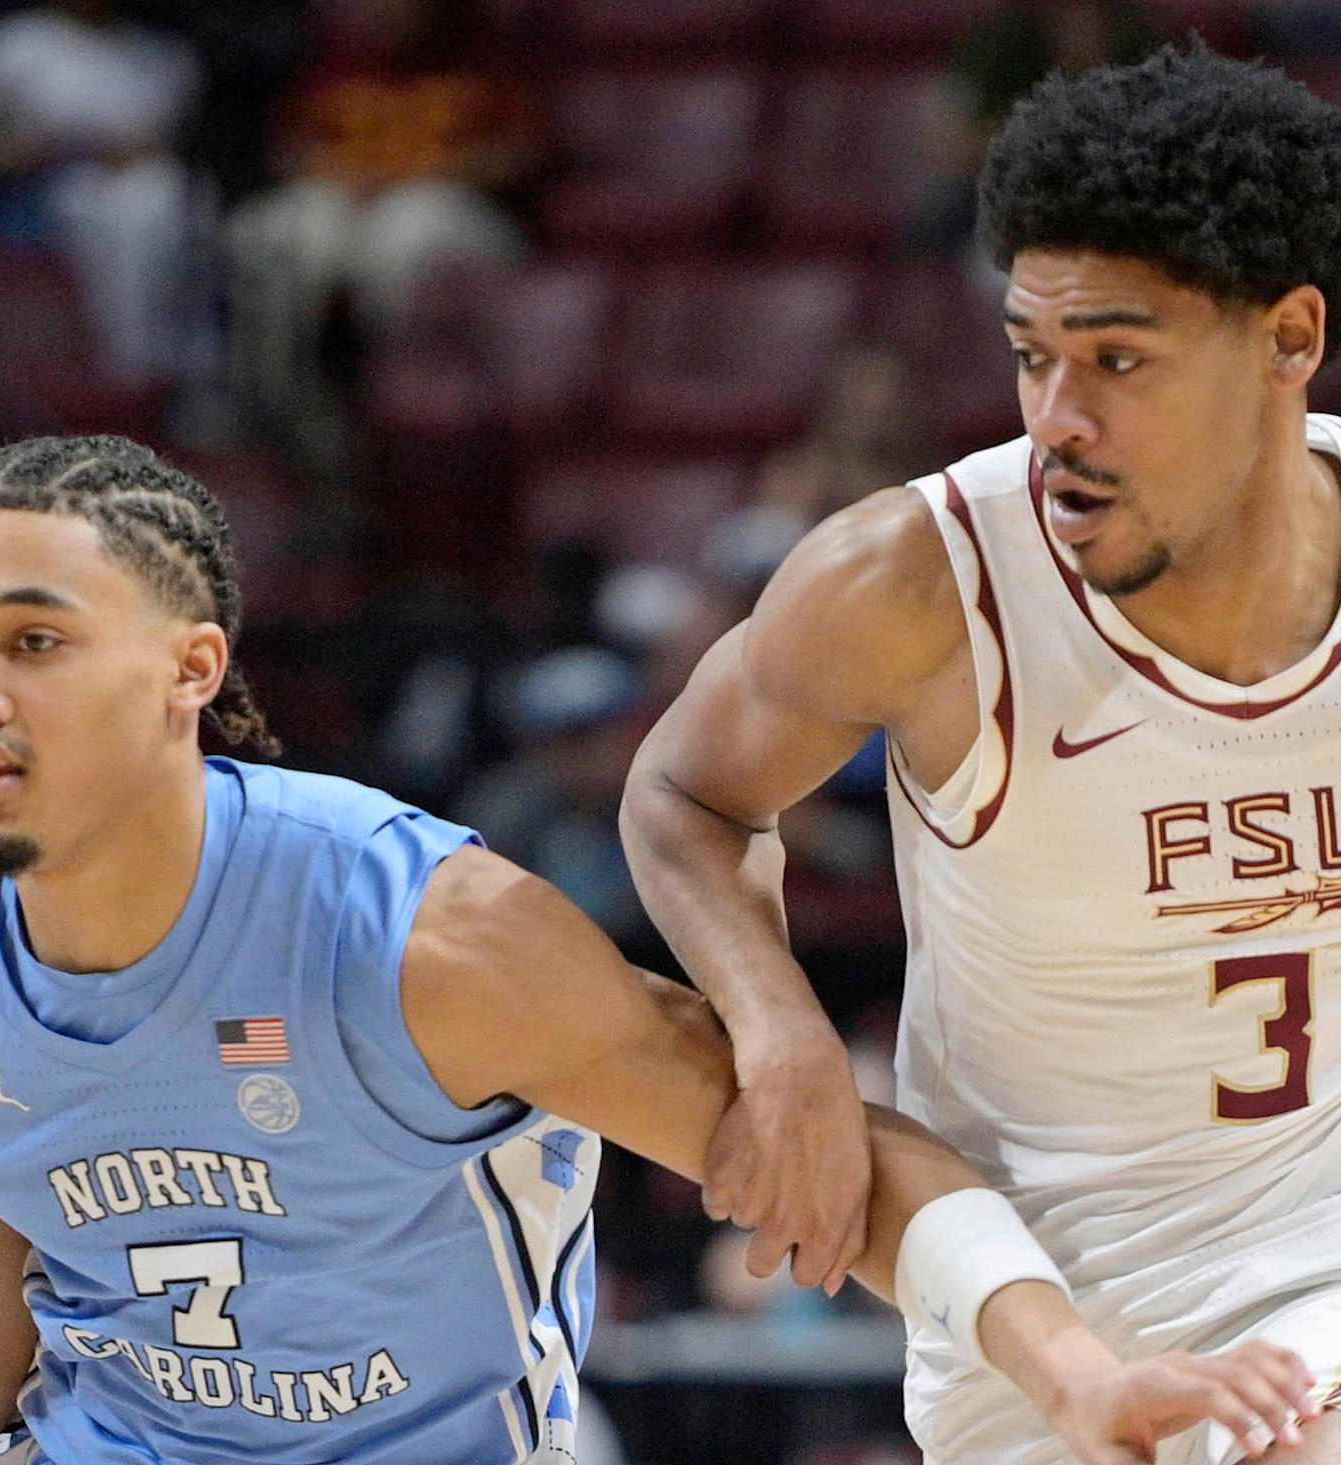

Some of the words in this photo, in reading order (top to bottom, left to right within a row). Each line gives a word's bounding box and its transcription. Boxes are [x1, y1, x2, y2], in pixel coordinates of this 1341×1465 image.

[1209, 949, 1316, 1125] 3
[47, 1148, 288, 1228] NORTH
[126, 1237, 245, 1349] 7
[63, 1324, 410, 1422] CAROLINA
